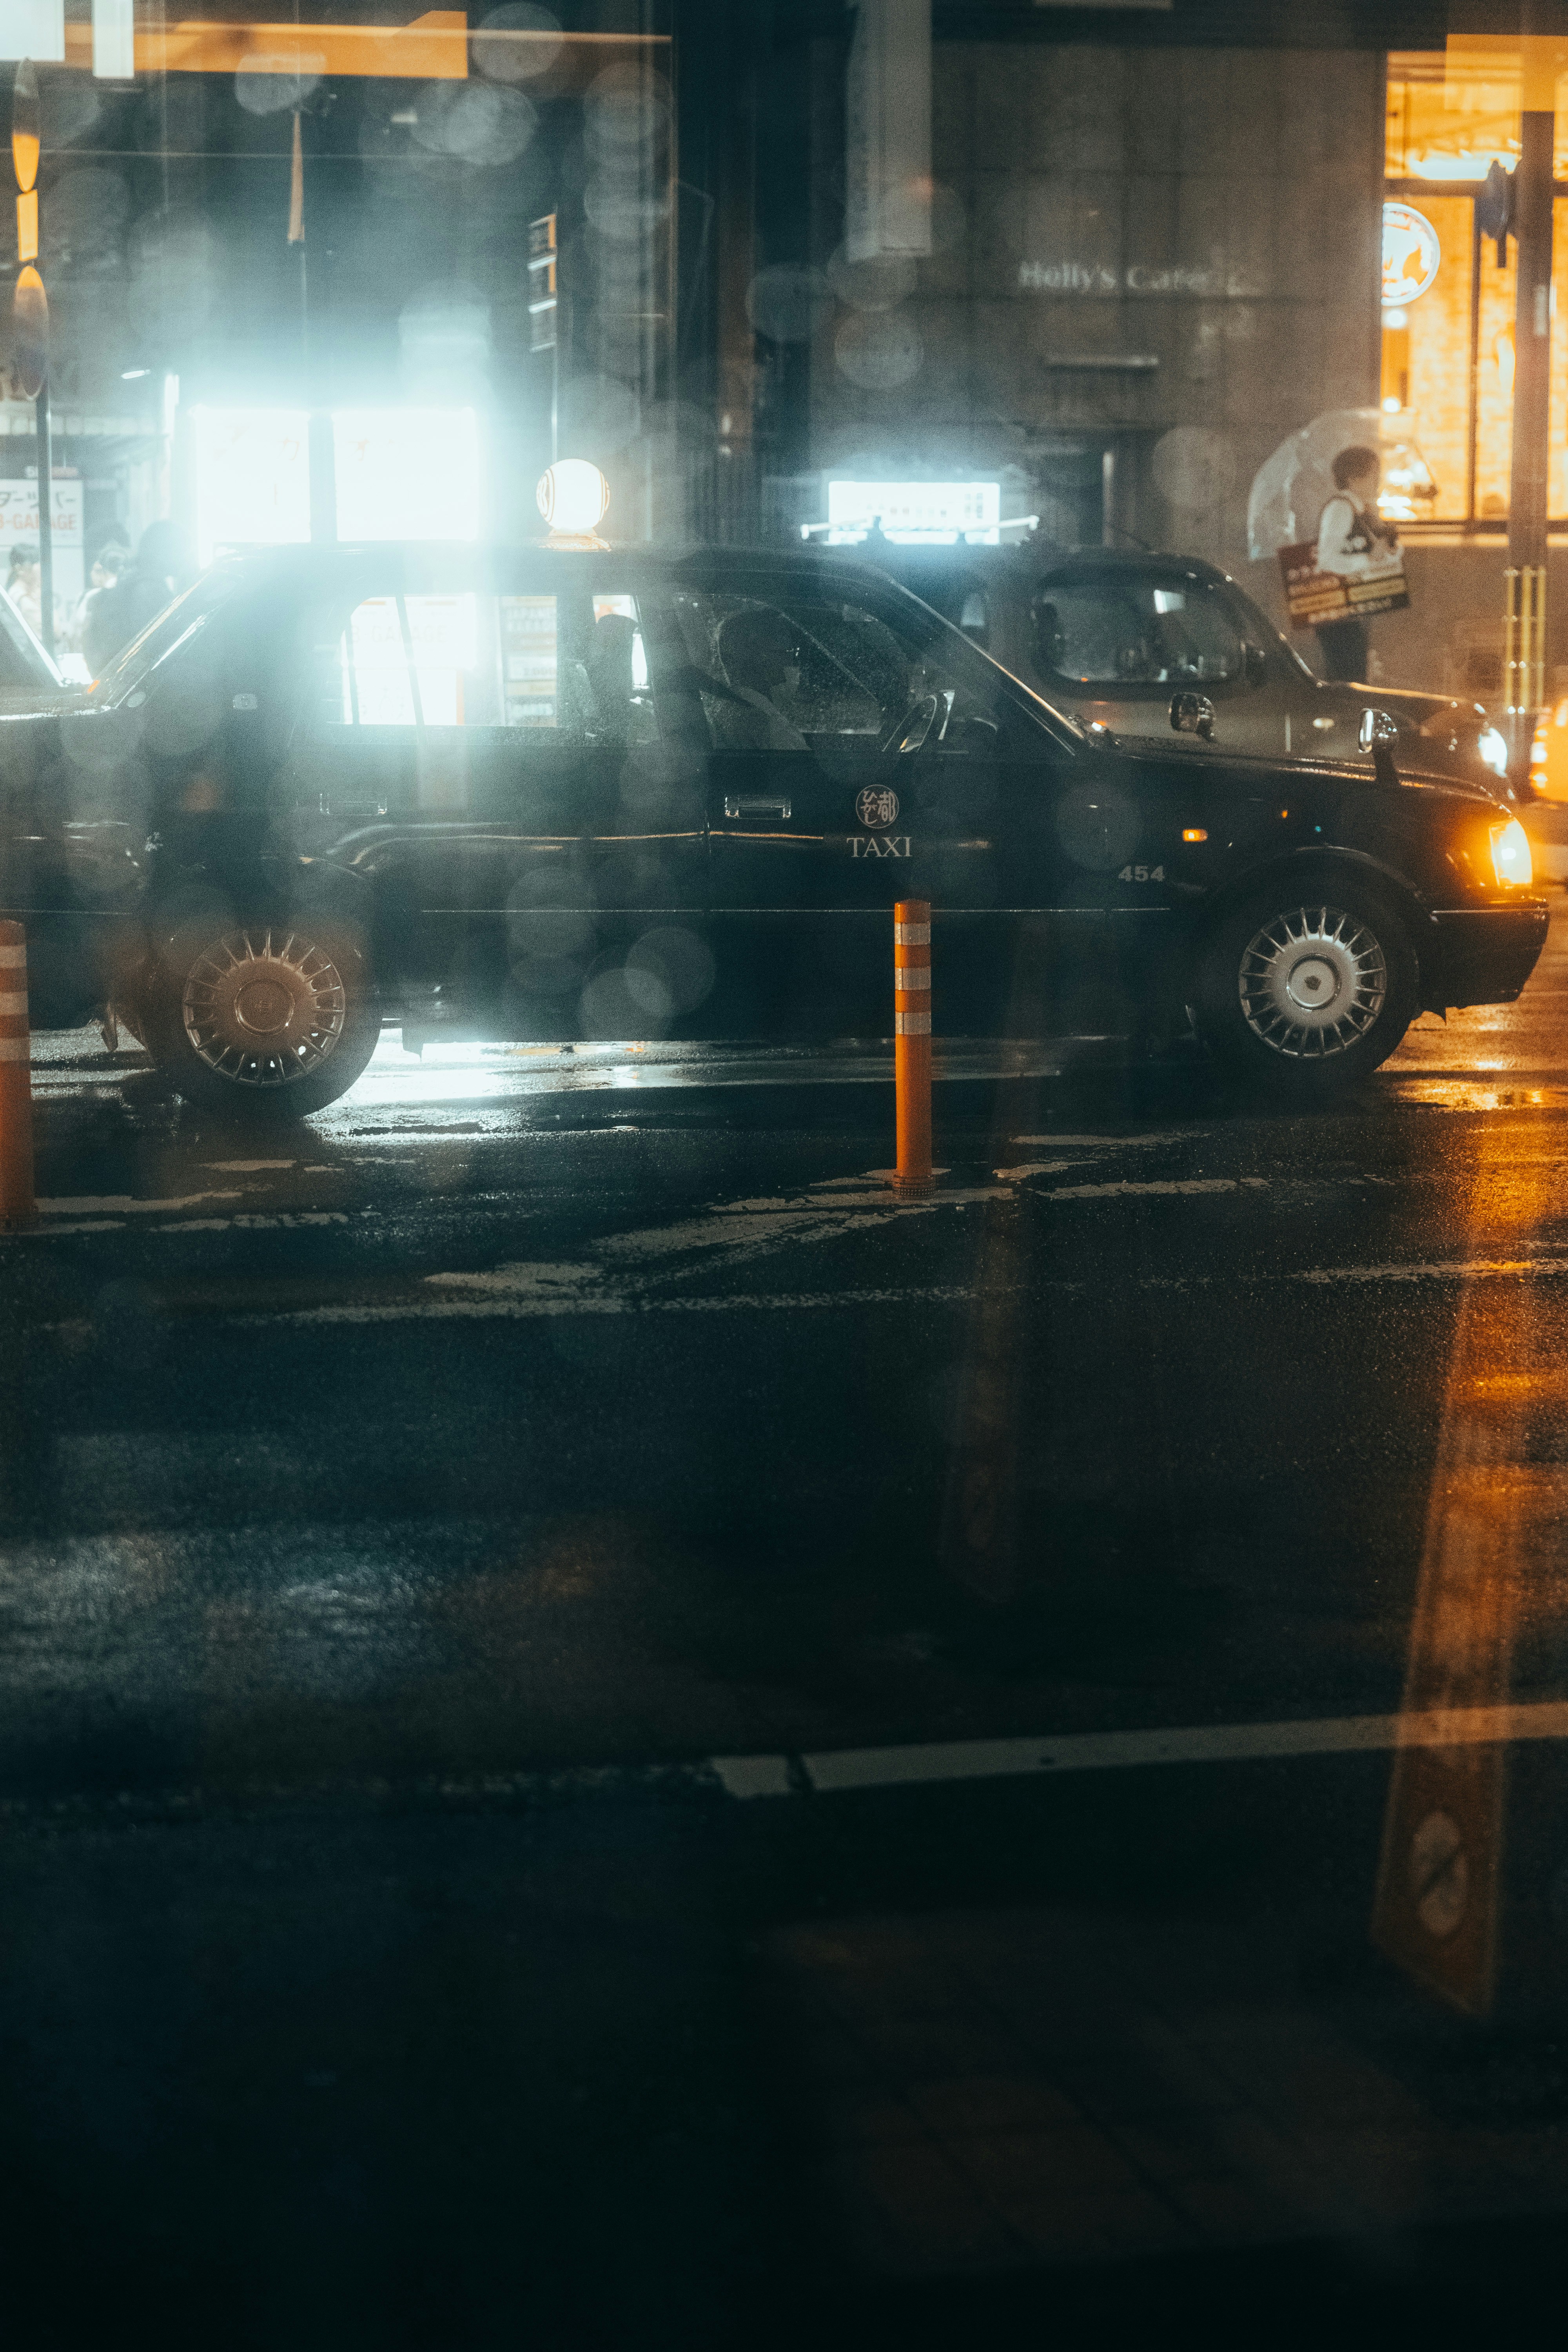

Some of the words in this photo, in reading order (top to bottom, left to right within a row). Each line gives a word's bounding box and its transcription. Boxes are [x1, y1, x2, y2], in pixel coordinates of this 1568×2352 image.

[1019, 260, 1116, 294] Holly's
[846, 837, 913, 858] TAXI
[1118, 865, 1165, 882] 454
